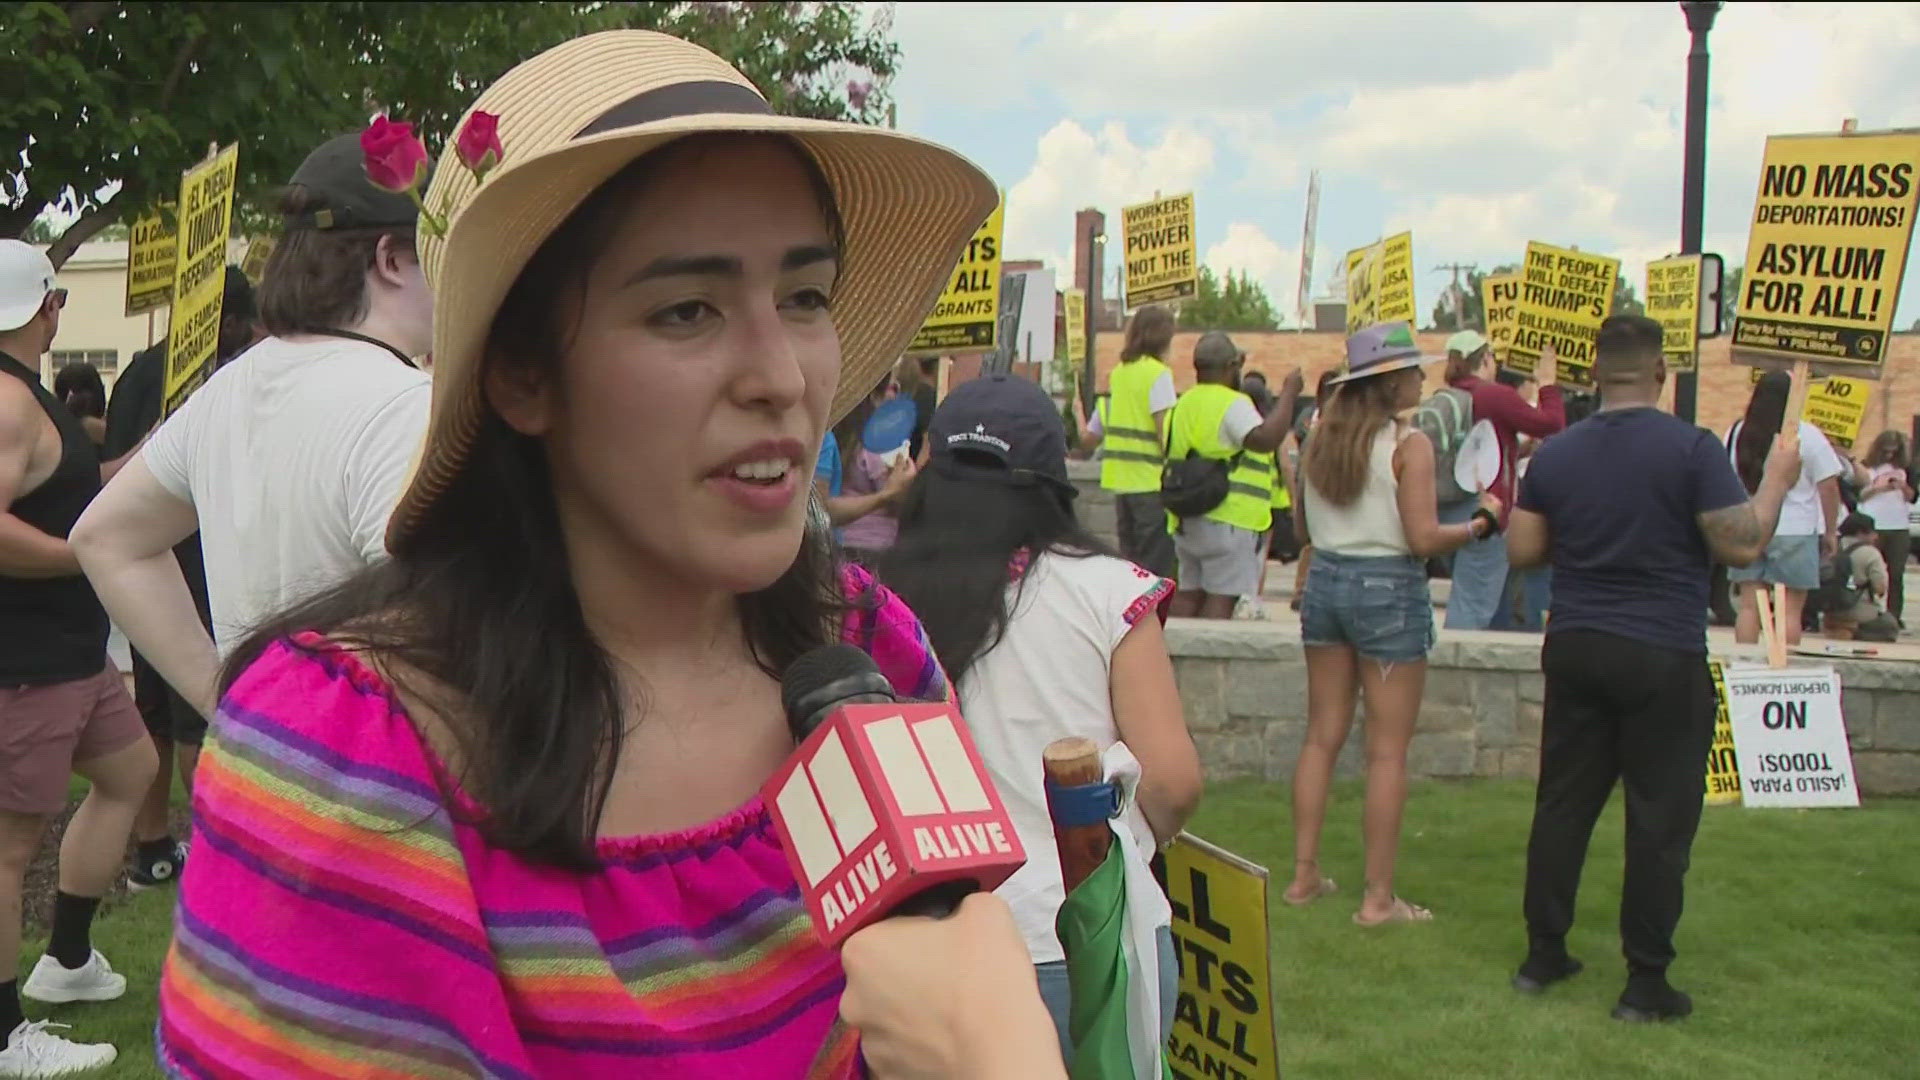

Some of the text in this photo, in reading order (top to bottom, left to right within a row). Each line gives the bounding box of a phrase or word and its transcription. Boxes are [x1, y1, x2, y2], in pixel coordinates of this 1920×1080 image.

[203, 161, 233, 203] PUEBLO
[1763, 163, 1912, 198] NO MASS
[1126, 197, 1190, 224] WORKERS
[1757, 204, 1906, 228] DEPORTATIONS!
[135, 225, 148, 246] LA
[187, 195, 226, 261] UNIDO
[1127, 224, 1190, 255] POWER
[1128, 249, 1191, 279] NOT THE
[1528, 249, 1612, 280] THE PEOPLE
[1757, 243, 1885, 281] ASYLUM
[954, 269, 992, 295] ALL
[1526, 268, 1608, 296] WILL DEFEAT
[1523, 282, 1605, 319] TRUMP'S
[1745, 279, 1882, 322] FOR ALL!
[1825, 380, 1852, 398] NO
[1731, 682, 1831, 696] DEPORTACIONES
[1762, 701, 1807, 730] NO
[1758, 752, 1833, 772] TODOS!
[1750, 778, 1793, 793] PARA
[912, 822, 1012, 862] ALIVE
[820, 840, 898, 934] ALIVE
